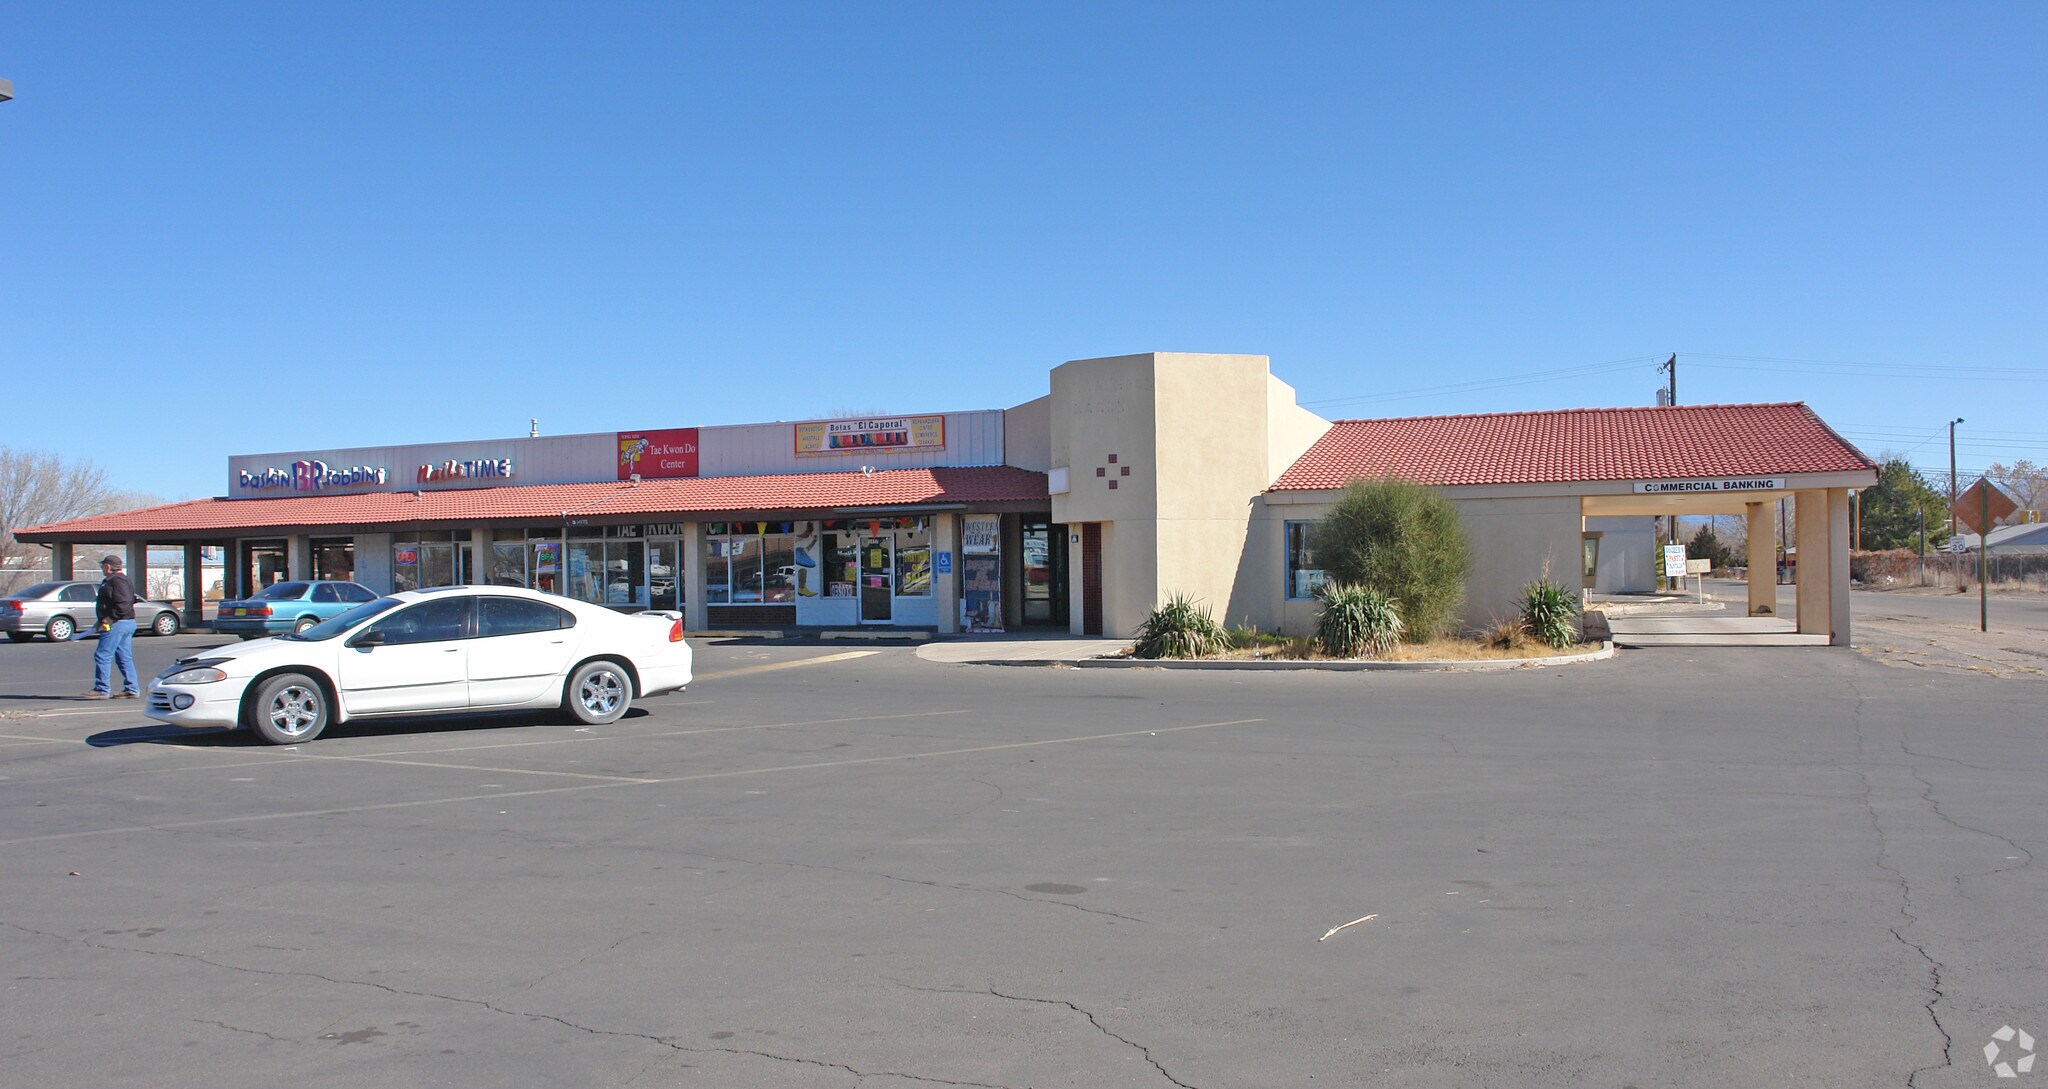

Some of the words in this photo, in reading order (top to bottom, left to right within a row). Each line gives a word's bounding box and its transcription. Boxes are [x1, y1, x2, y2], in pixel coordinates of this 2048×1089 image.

[650, 446, 662, 455] Tae
[663, 444, 684, 455] Kwon
[685, 443, 696, 454] Do
[661, 460, 685, 469] Center
[1645, 482, 1718, 492] COMMERCIAL
[1723, 480, 1774, 490] BANKING
